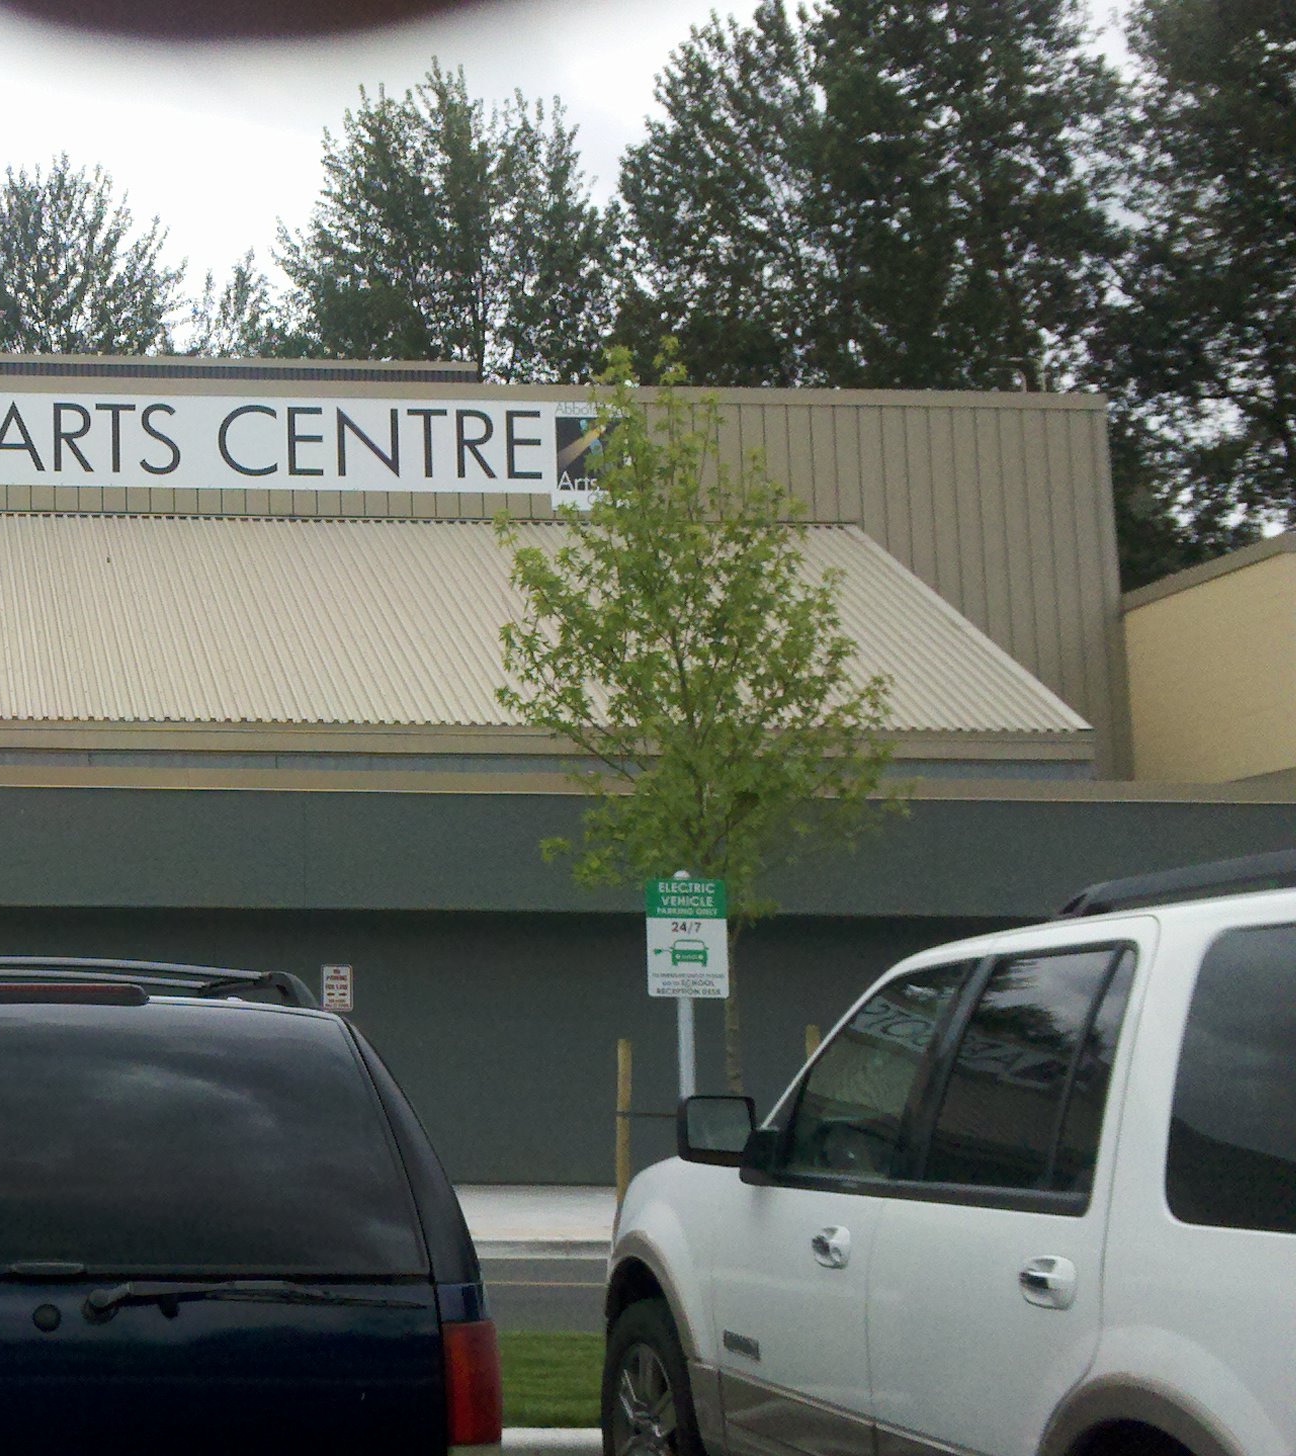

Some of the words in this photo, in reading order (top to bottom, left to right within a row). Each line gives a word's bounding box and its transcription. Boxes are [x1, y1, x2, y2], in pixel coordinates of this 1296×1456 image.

[218, 404, 543, 480] CENTRE
[658, 882, 716, 893] ELECTRIC
[661, 896, 714, 907] VEHICLE
[656, 907, 694, 915] PARKING
[671, 921, 702, 935] 24/7
